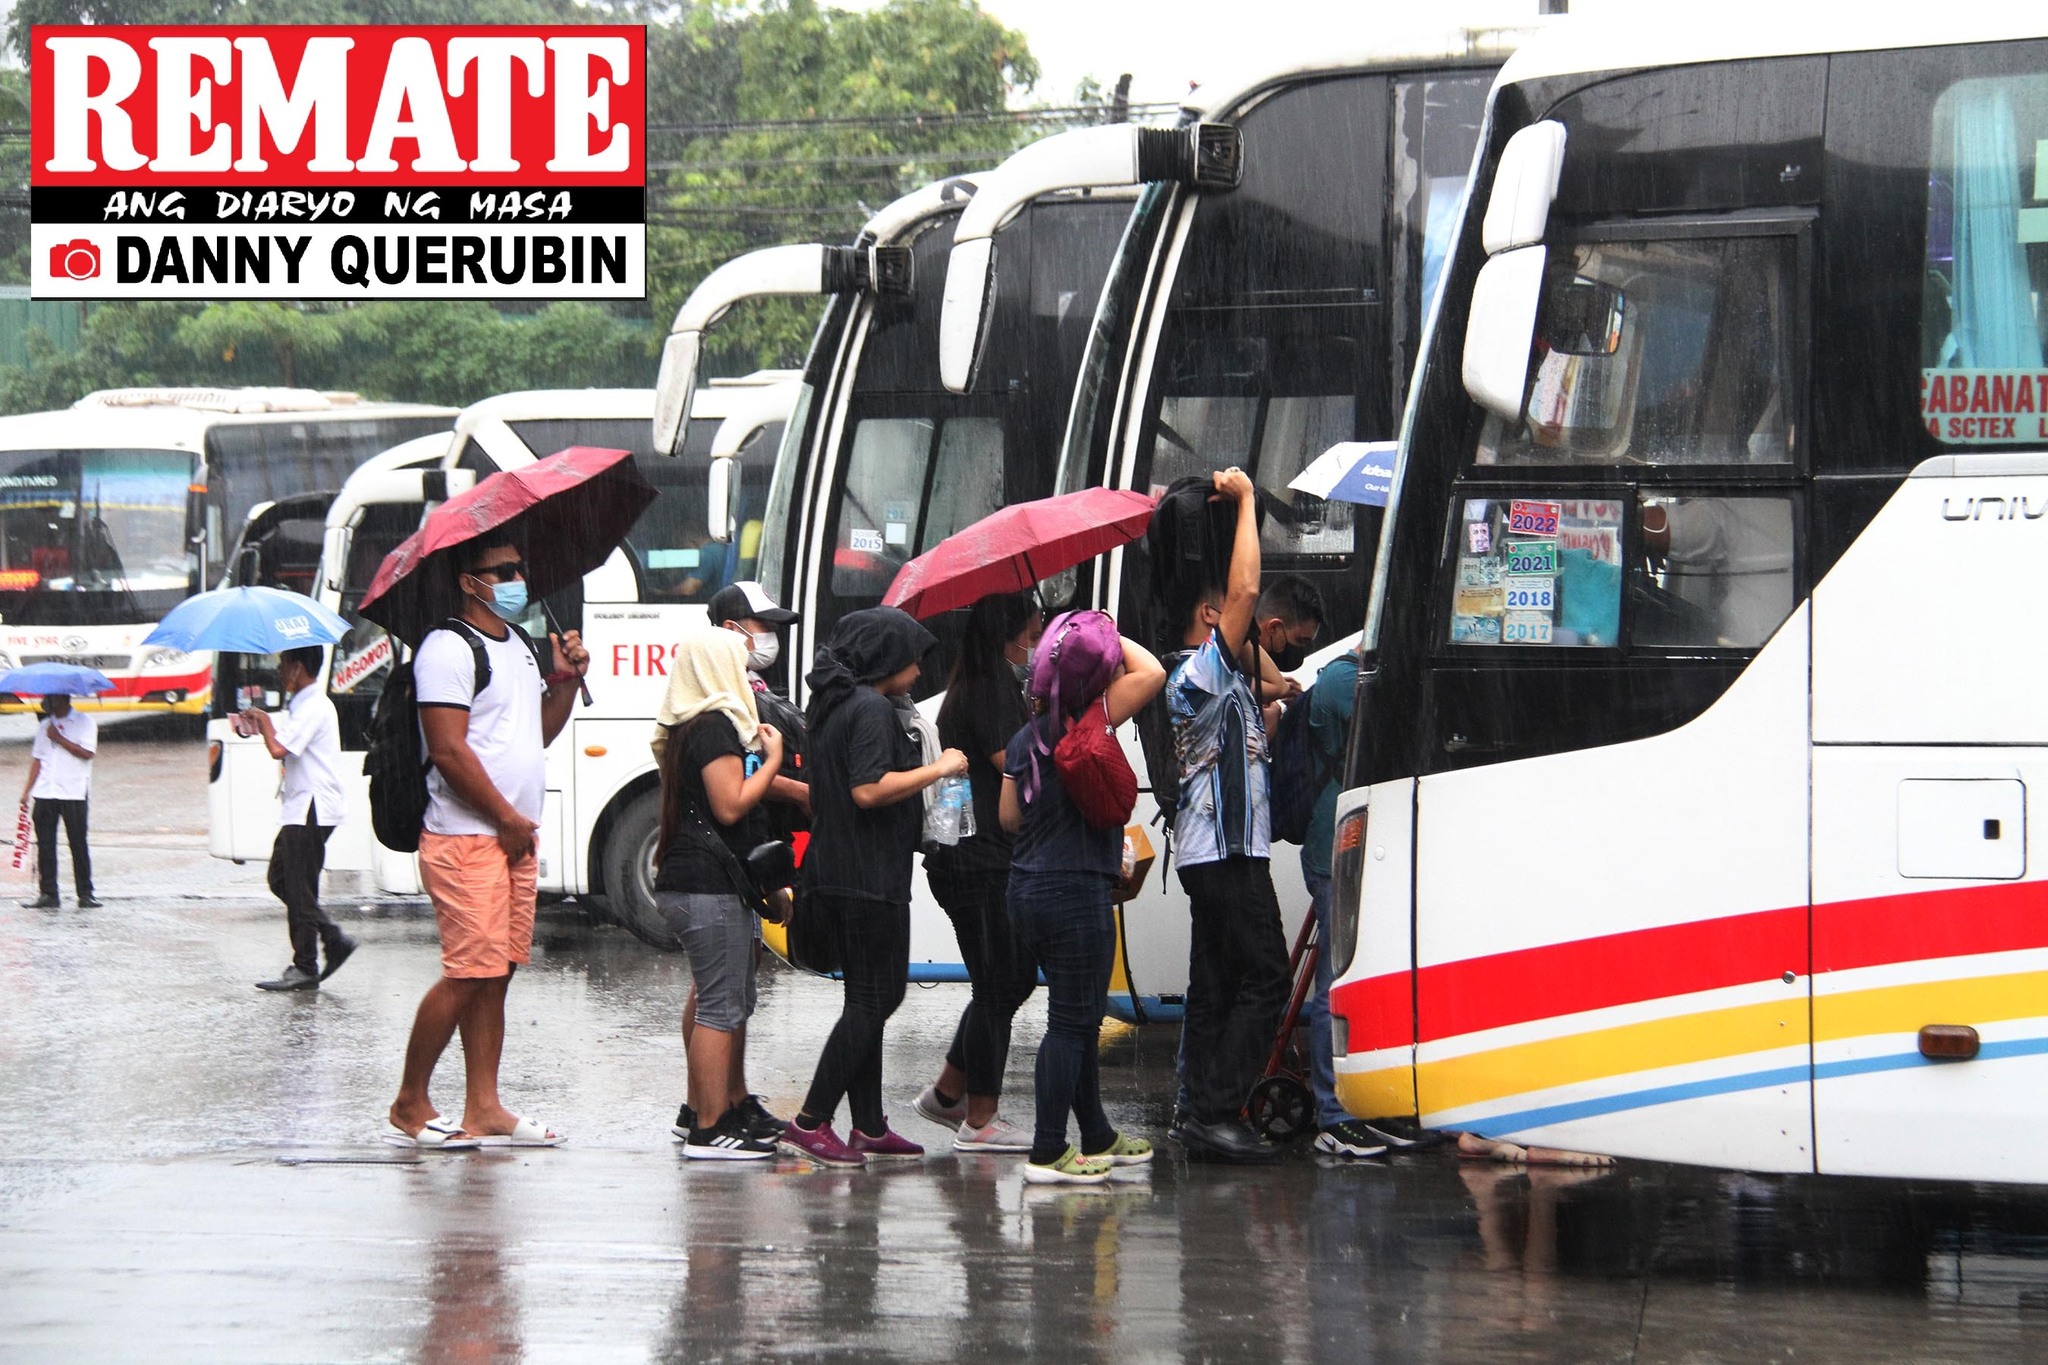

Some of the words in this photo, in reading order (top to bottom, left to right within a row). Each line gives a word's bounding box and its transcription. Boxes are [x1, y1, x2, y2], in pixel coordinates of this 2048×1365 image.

[1948, 417, 2016, 438] SCTEX
[1512, 514, 1556, 533] 2022
[853, 537, 882, 549] 2015
[1511, 556, 1552, 572] 2021
[1507, 591, 1551, 607] 2018
[1506, 623, 1550, 640] 2017
[335, 638, 391, 688] HAGONOY
